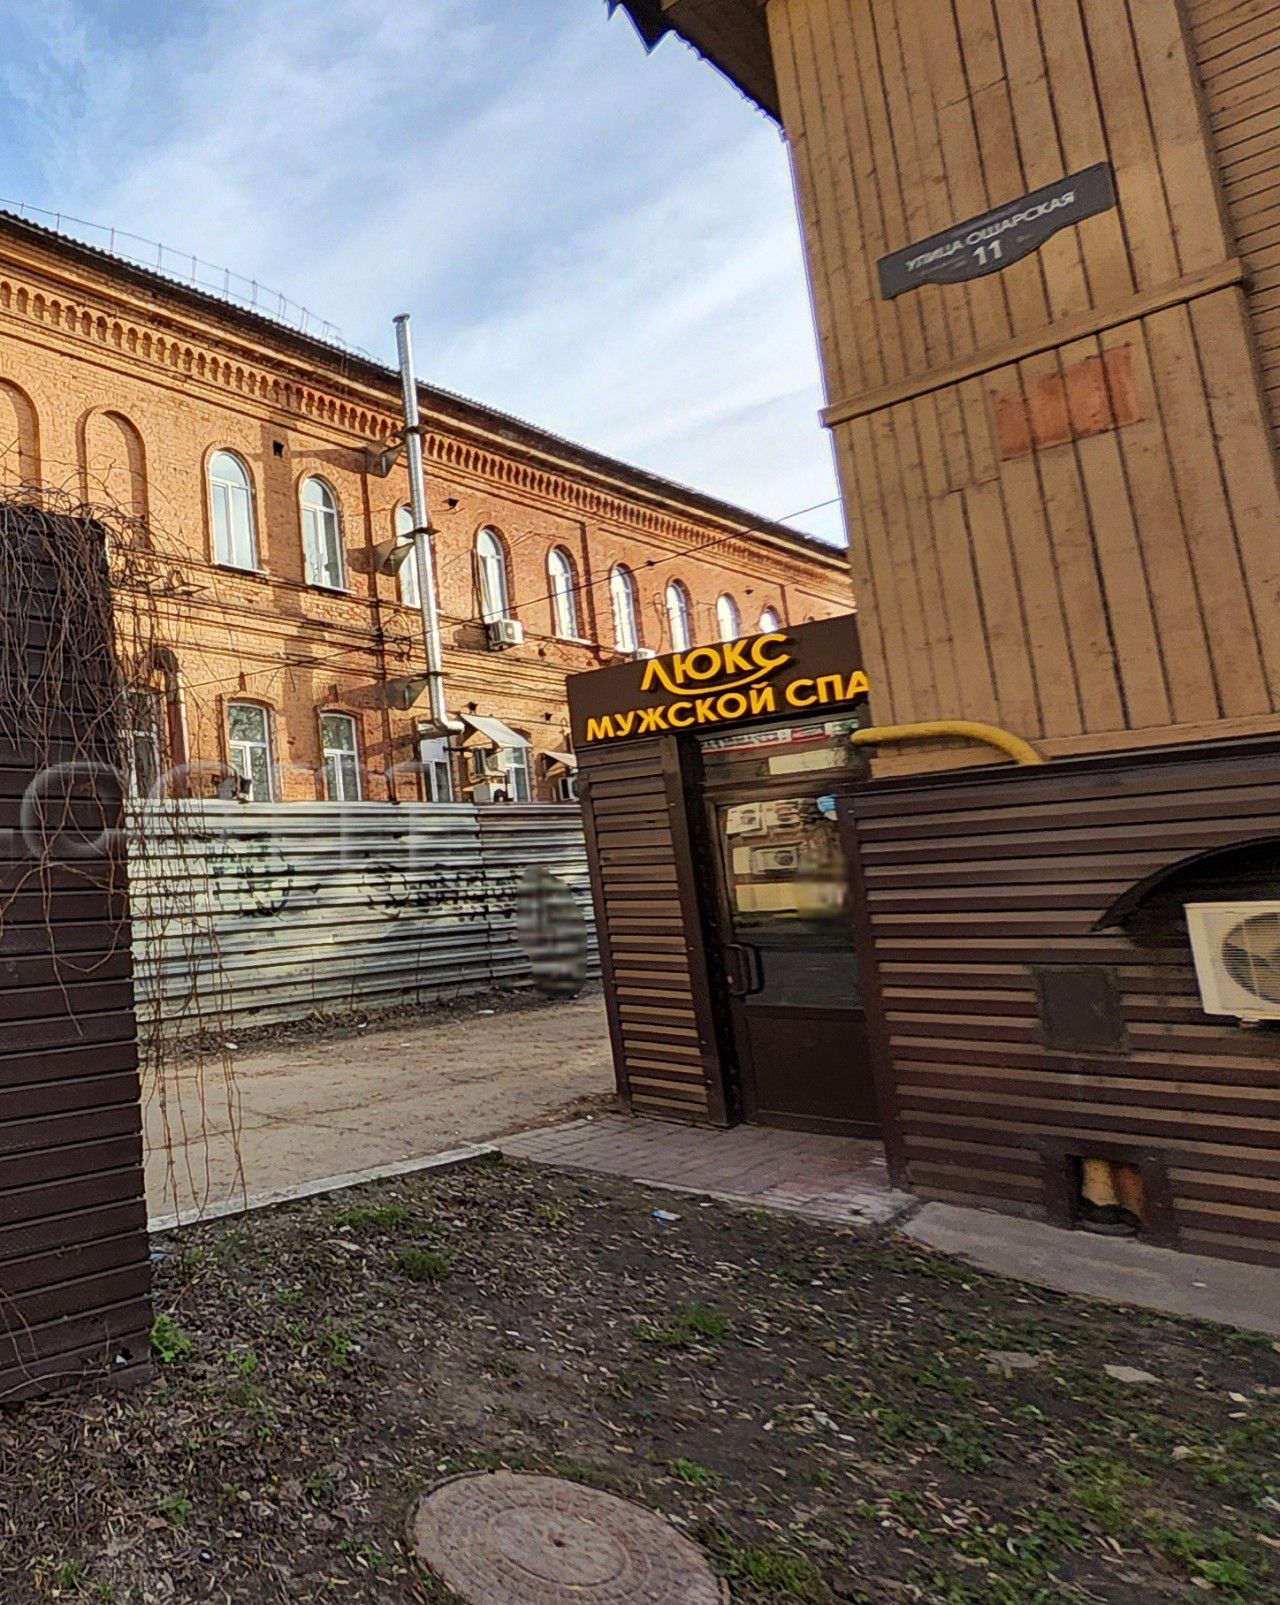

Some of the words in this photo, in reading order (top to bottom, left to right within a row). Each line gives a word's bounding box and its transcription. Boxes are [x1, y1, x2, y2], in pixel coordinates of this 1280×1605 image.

[905, 240, 965, 273] УЛИЦА
[965, 191, 1076, 245] ОШАРСКАЯ
[973, 239, 1003, 266] 11
[640, 633, 791, 695] ЛЮКС
[586, 682, 775, 742] МУЖСКОЙ
[785, 670, 870, 707] СПА
